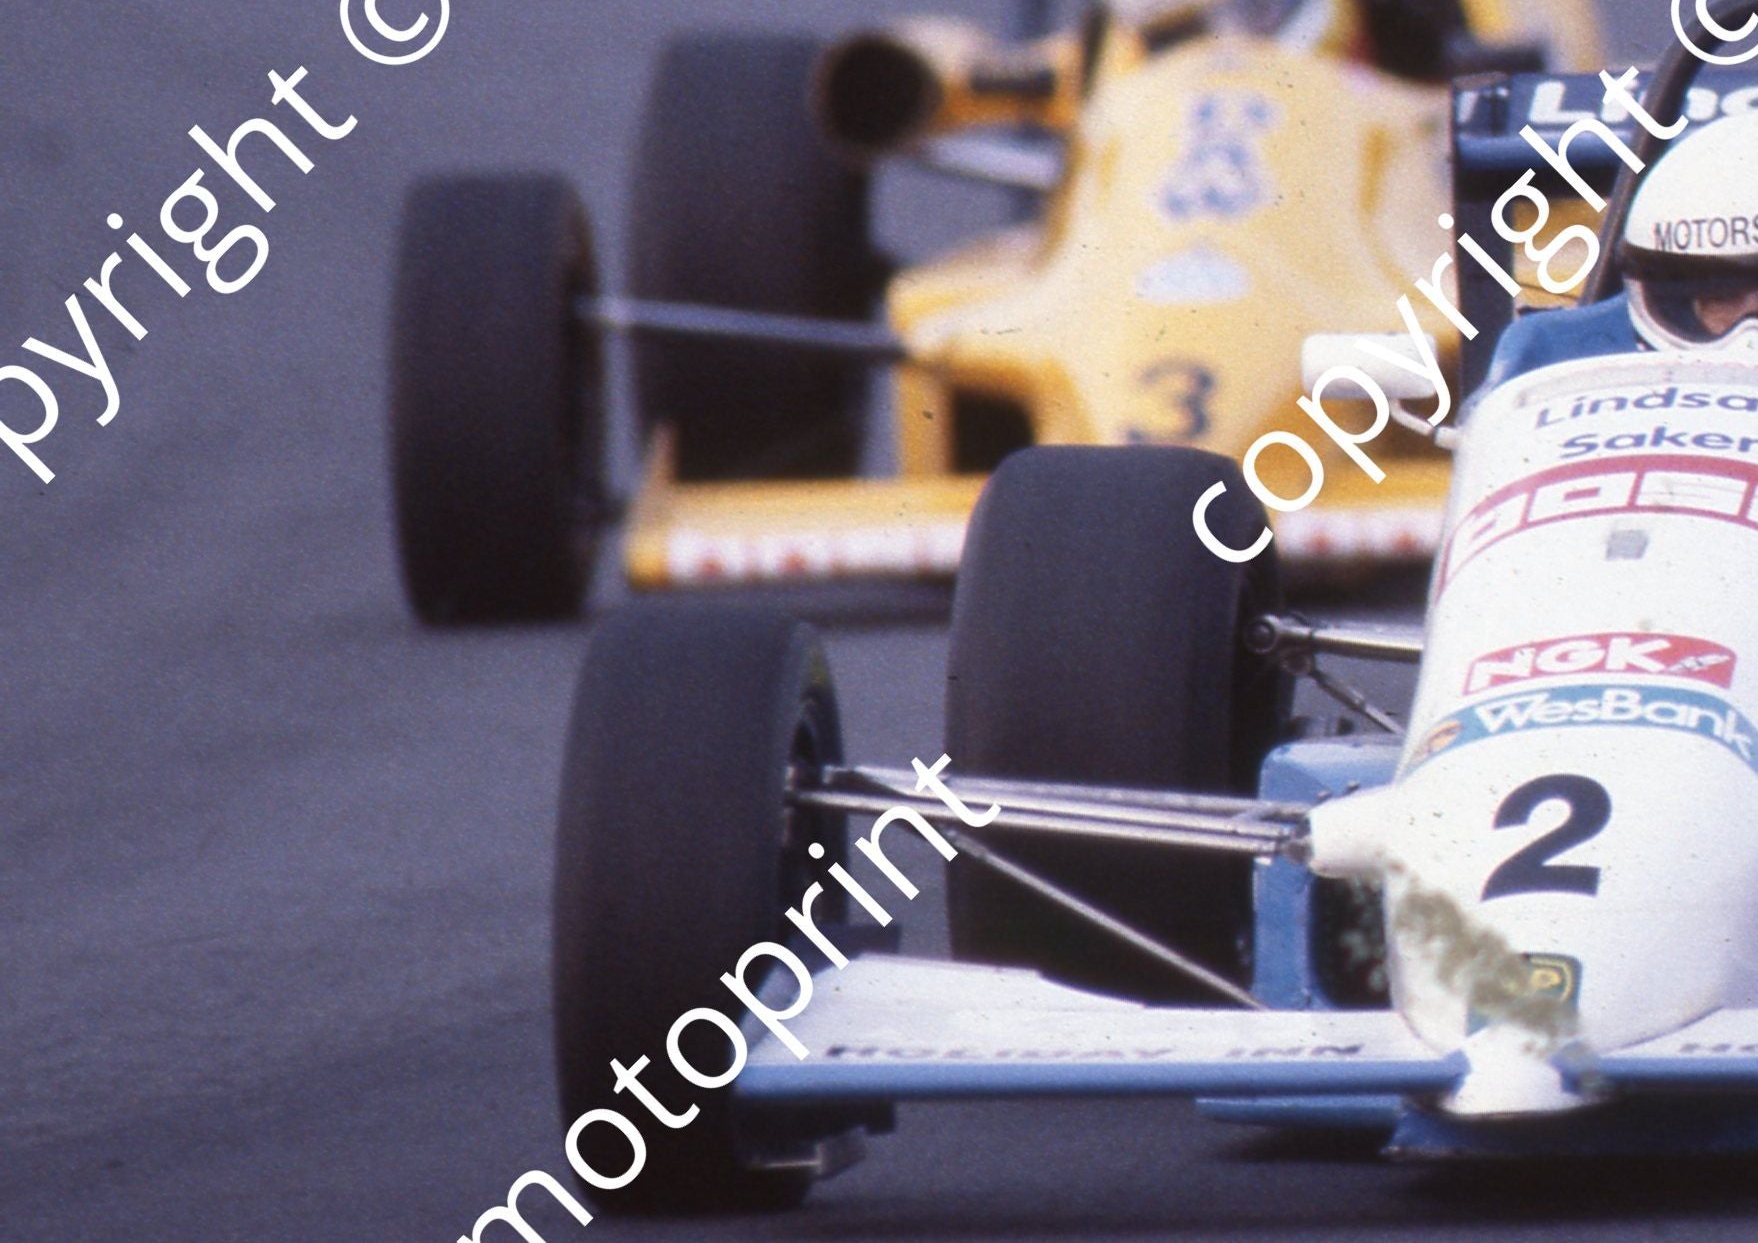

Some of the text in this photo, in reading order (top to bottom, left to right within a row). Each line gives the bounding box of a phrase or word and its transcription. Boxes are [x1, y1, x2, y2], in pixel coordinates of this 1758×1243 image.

[1466, 635, 1673, 695] NGK
[1473, 687, 1754, 760] WesBank
[1479, 772, 1613, 903] 2
